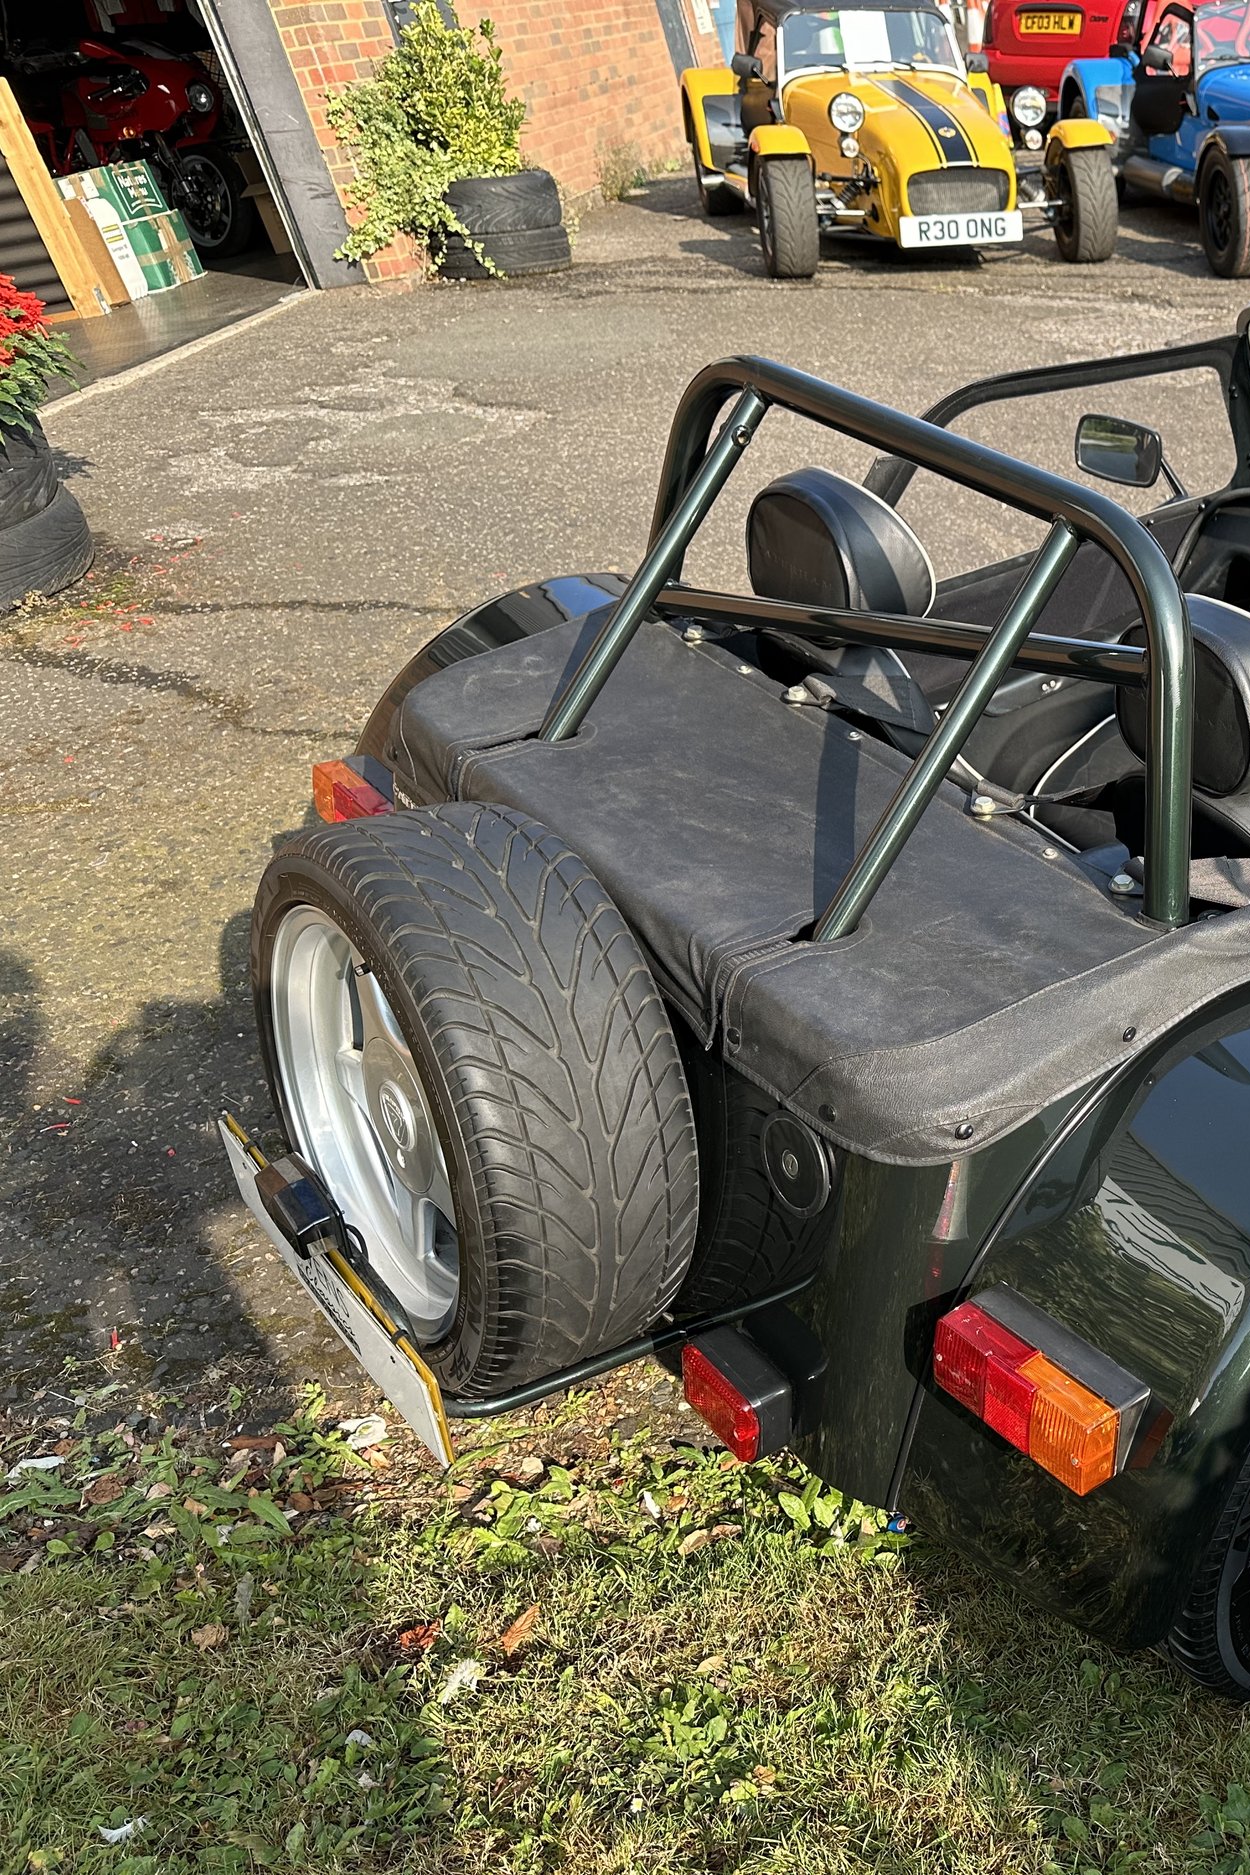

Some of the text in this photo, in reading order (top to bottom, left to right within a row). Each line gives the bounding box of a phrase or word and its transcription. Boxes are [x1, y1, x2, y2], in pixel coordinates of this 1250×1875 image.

[1024, 15, 1050, 30] CF03
[918, 217, 1006, 242] R30 ONG
